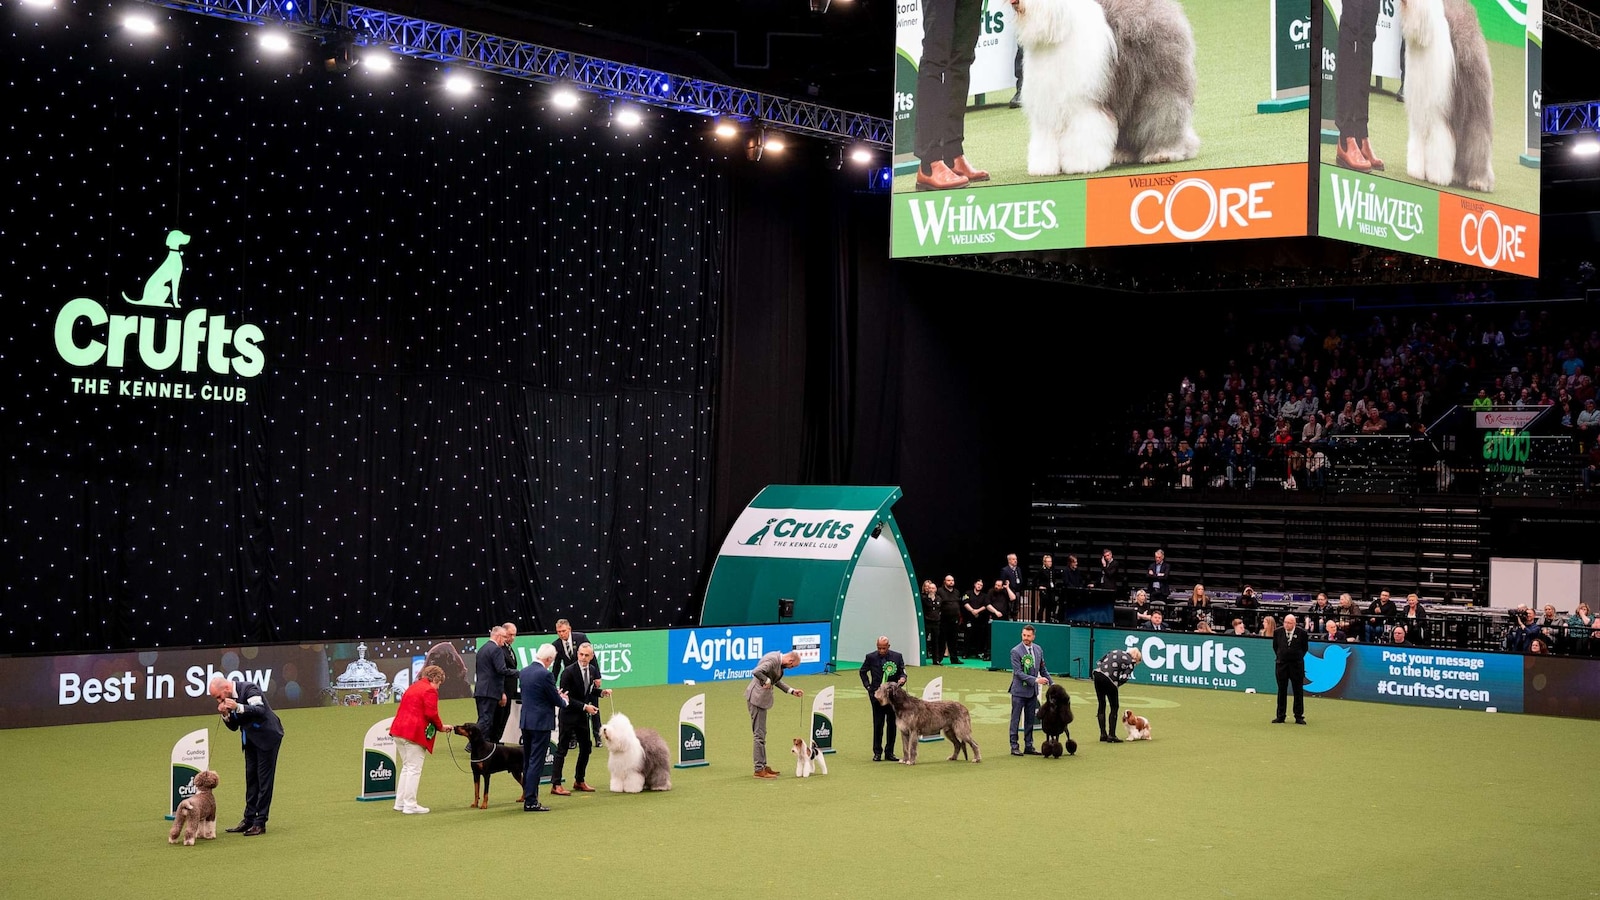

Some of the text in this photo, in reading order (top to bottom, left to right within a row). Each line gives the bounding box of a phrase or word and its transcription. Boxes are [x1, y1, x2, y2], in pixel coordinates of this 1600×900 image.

[1129, 174, 1178, 188] WELLNESS
[1130, 177, 1274, 240] CORE
[951, 232, 996, 245] WELLNESS
[1460, 209, 1527, 267] CORE
[54, 297, 266, 378] Crufts
[71, 377, 247, 402] THE KENNEL CLUB
[773, 518, 854, 540] Crufts
[789, 541, 817, 549] KENNEL
[682, 628, 746, 670] Agria
[1141, 635, 1246, 675] Crufts
[1382, 650, 1484, 670] Post your message
[713, 668, 727, 680] Pet
[1150, 673, 1237, 687] THE KENNEL CLUB
[1389, 664, 1480, 681] to the big screen
[58, 671, 137, 705] Best
[146, 666, 175, 700] in
[1377, 680, 1490, 702] #CruftsScreen
[369, 769, 392, 778] Crufts
